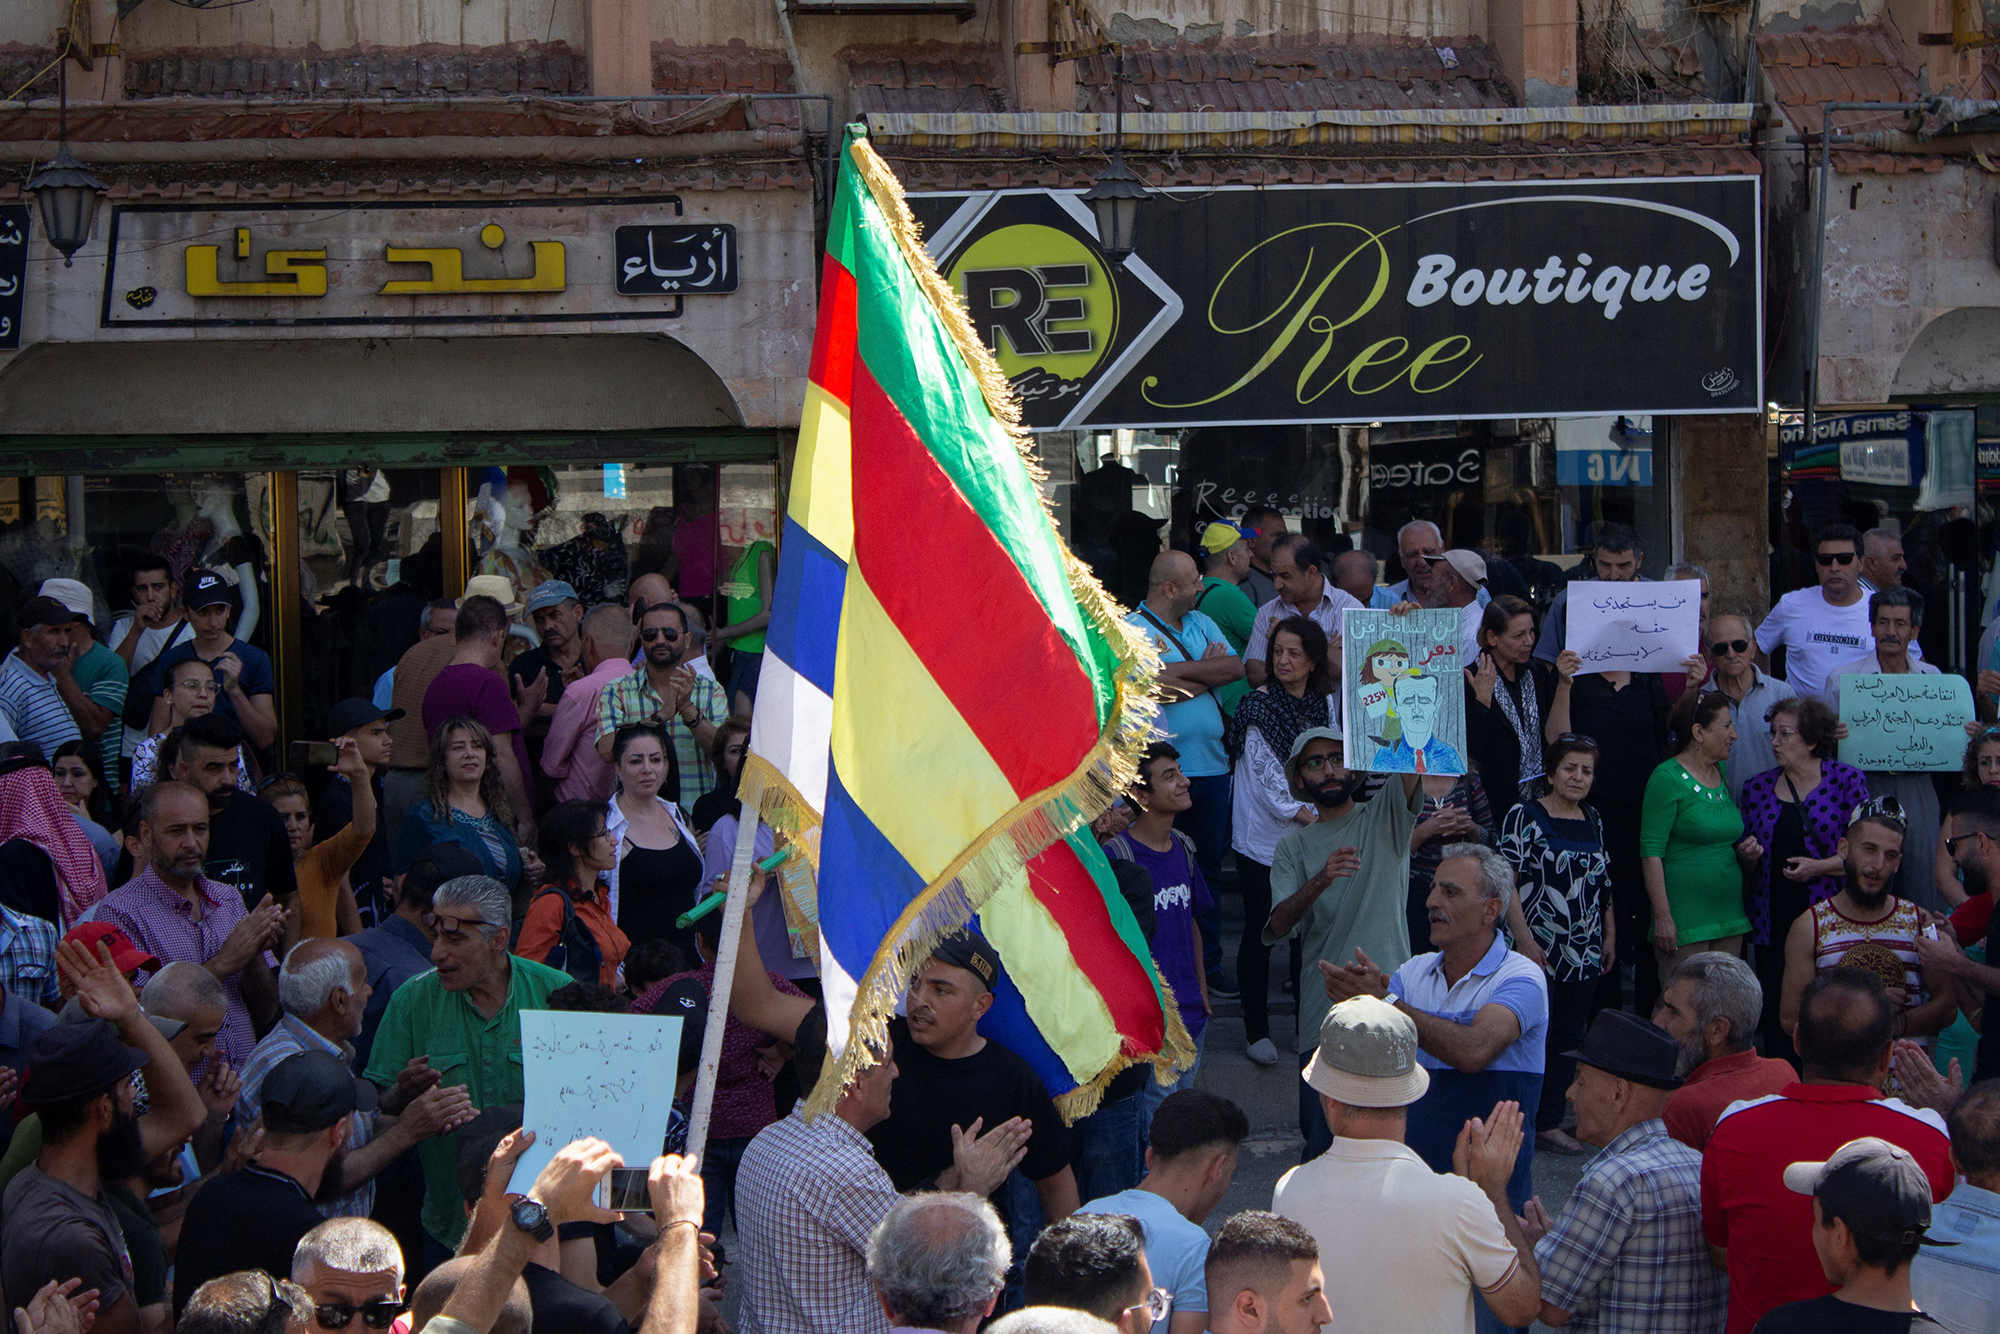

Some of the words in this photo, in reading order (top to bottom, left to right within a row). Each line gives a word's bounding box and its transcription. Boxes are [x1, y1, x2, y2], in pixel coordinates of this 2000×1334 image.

[961, 263, 1092, 356] RE
[1141, 222, 1483, 408] Ree
[1406, 252, 1710, 321] Boutique
[1814, 634, 1860, 646] GIVENCHY
[1363, 690, 1386, 706] 2254
